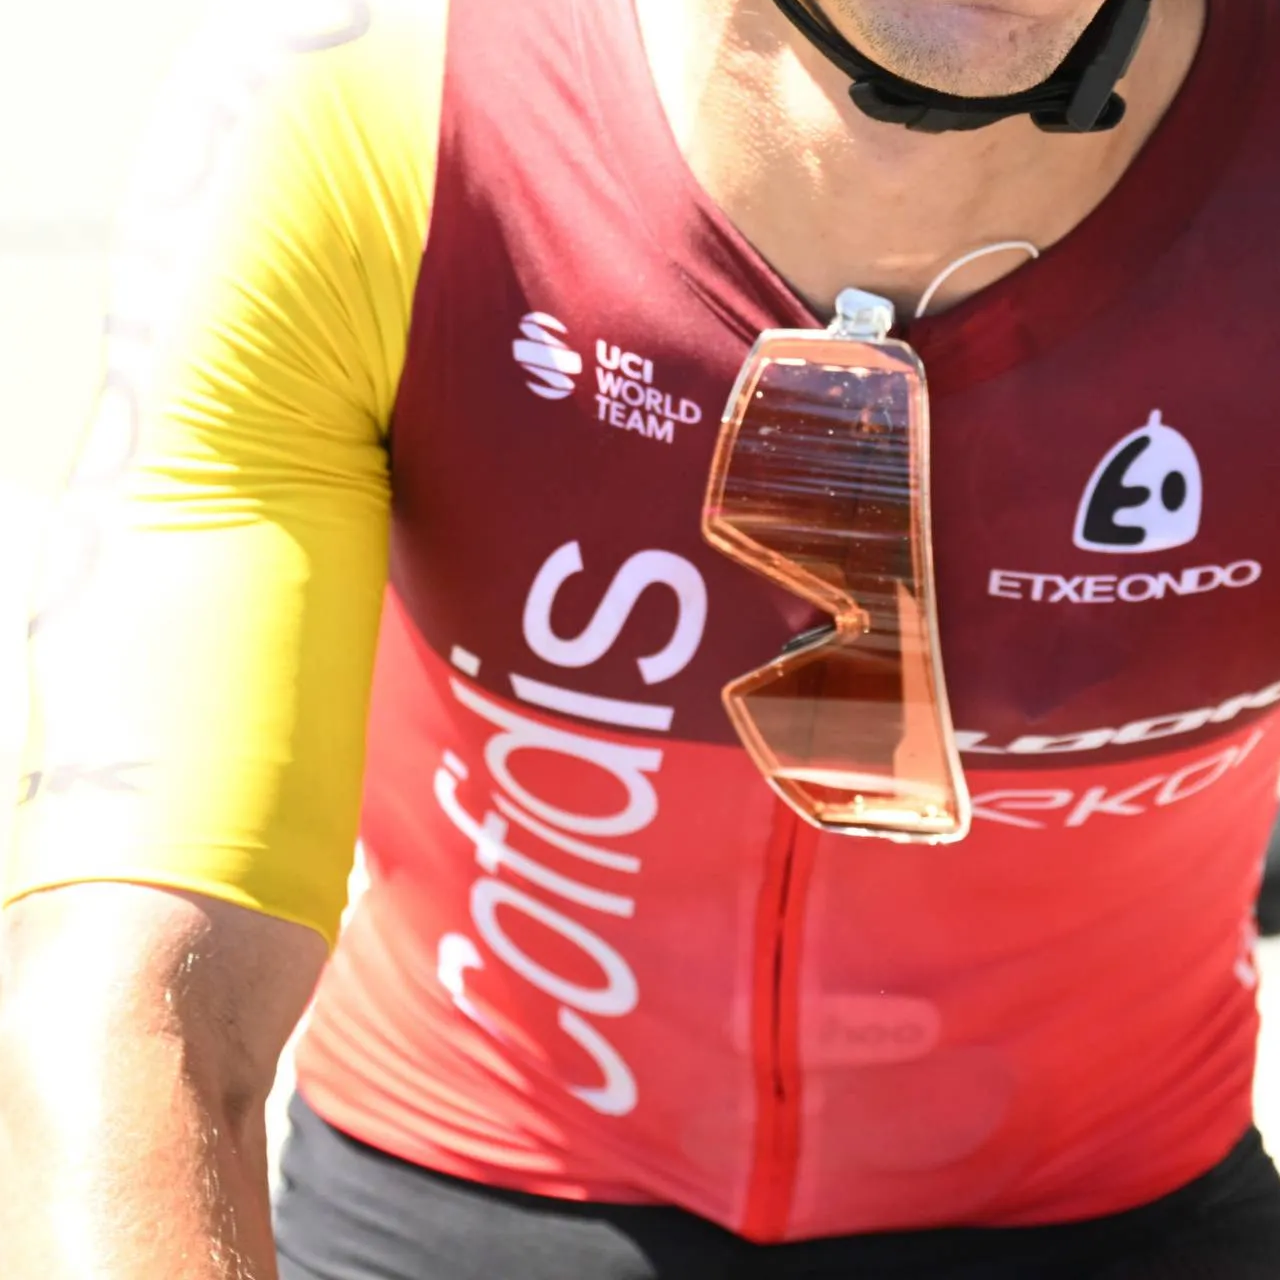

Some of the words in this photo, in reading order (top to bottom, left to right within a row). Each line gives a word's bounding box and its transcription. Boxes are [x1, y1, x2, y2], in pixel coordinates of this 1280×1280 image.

[595, 338, 653, 384] UCI
[594, 395, 675, 444] TEAM
[595, 367, 702, 424] WORLD
[987, 559, 1262, 603] ETXEONDO
[433, 540, 708, 1115] cofidis
